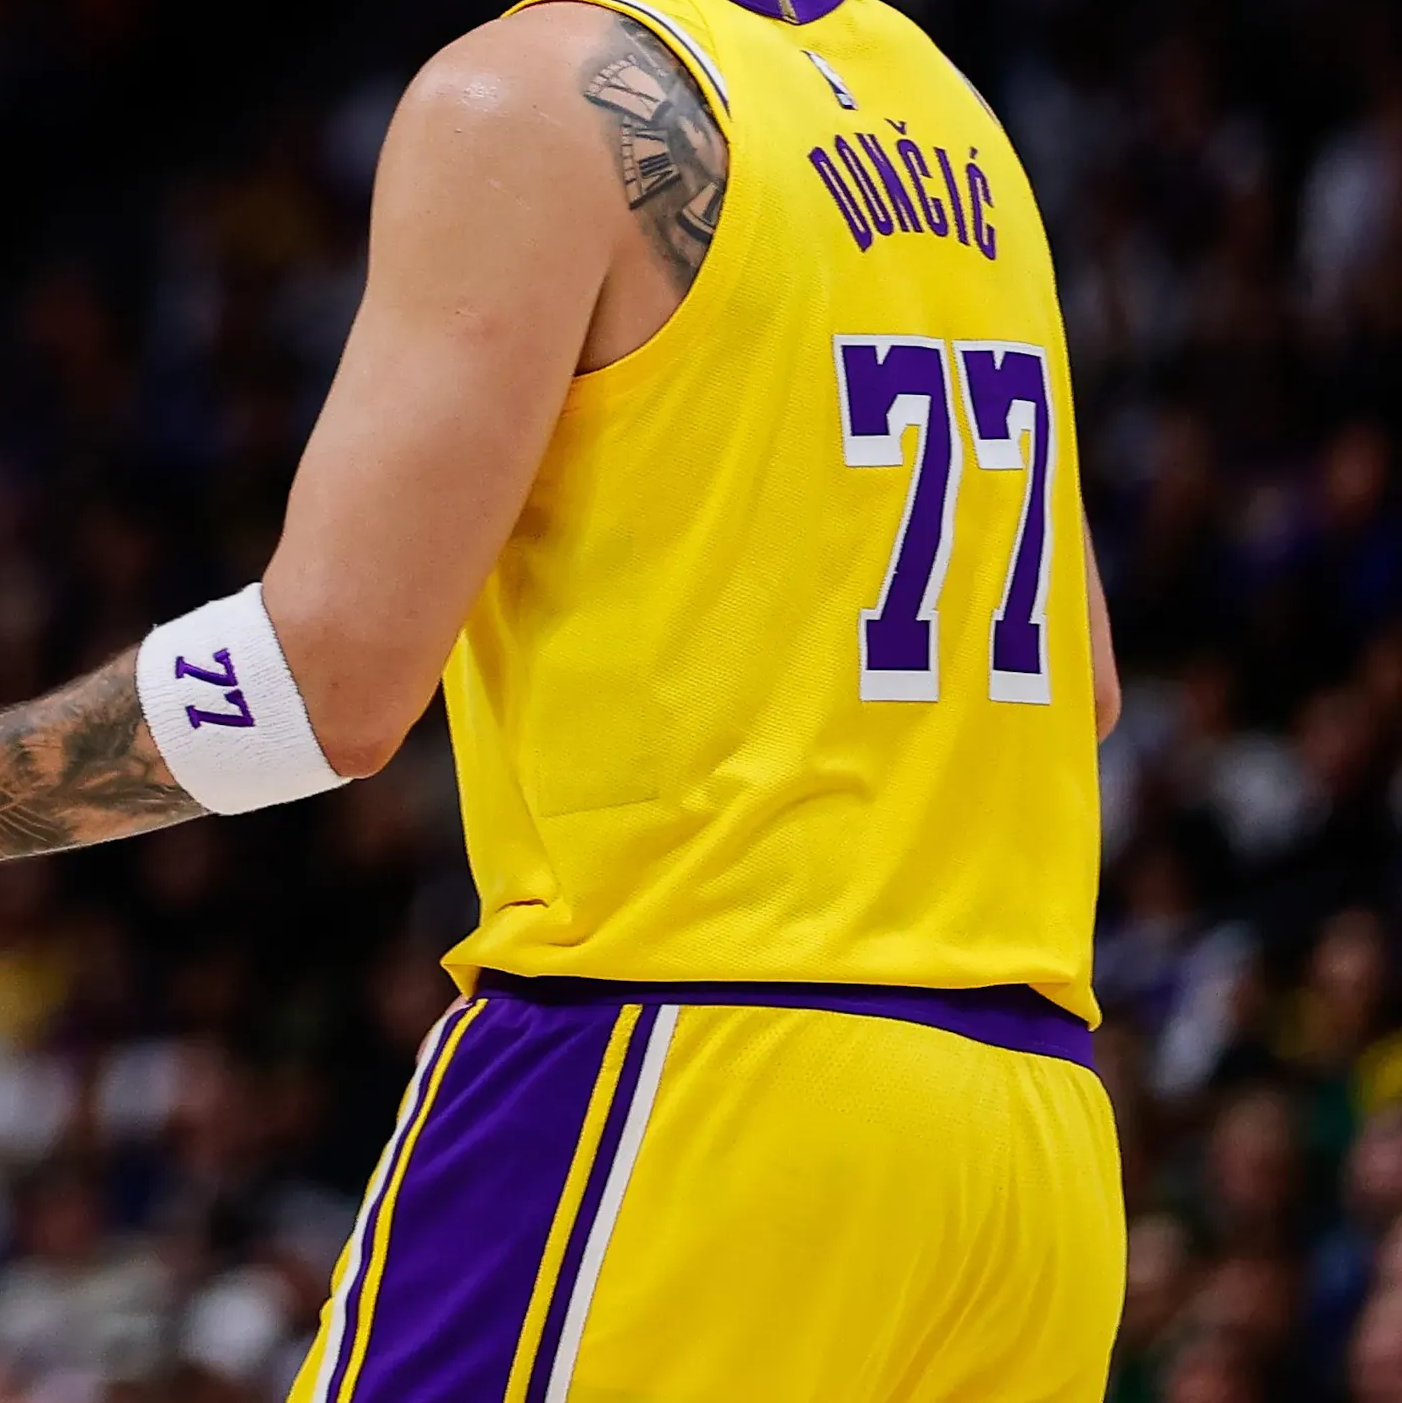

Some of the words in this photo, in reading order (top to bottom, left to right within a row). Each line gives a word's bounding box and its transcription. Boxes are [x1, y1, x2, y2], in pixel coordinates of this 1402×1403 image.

[807, 117, 997, 261] DONČIĆ
[831, 333, 1055, 706] 77
[174, 648, 256, 730] 77
